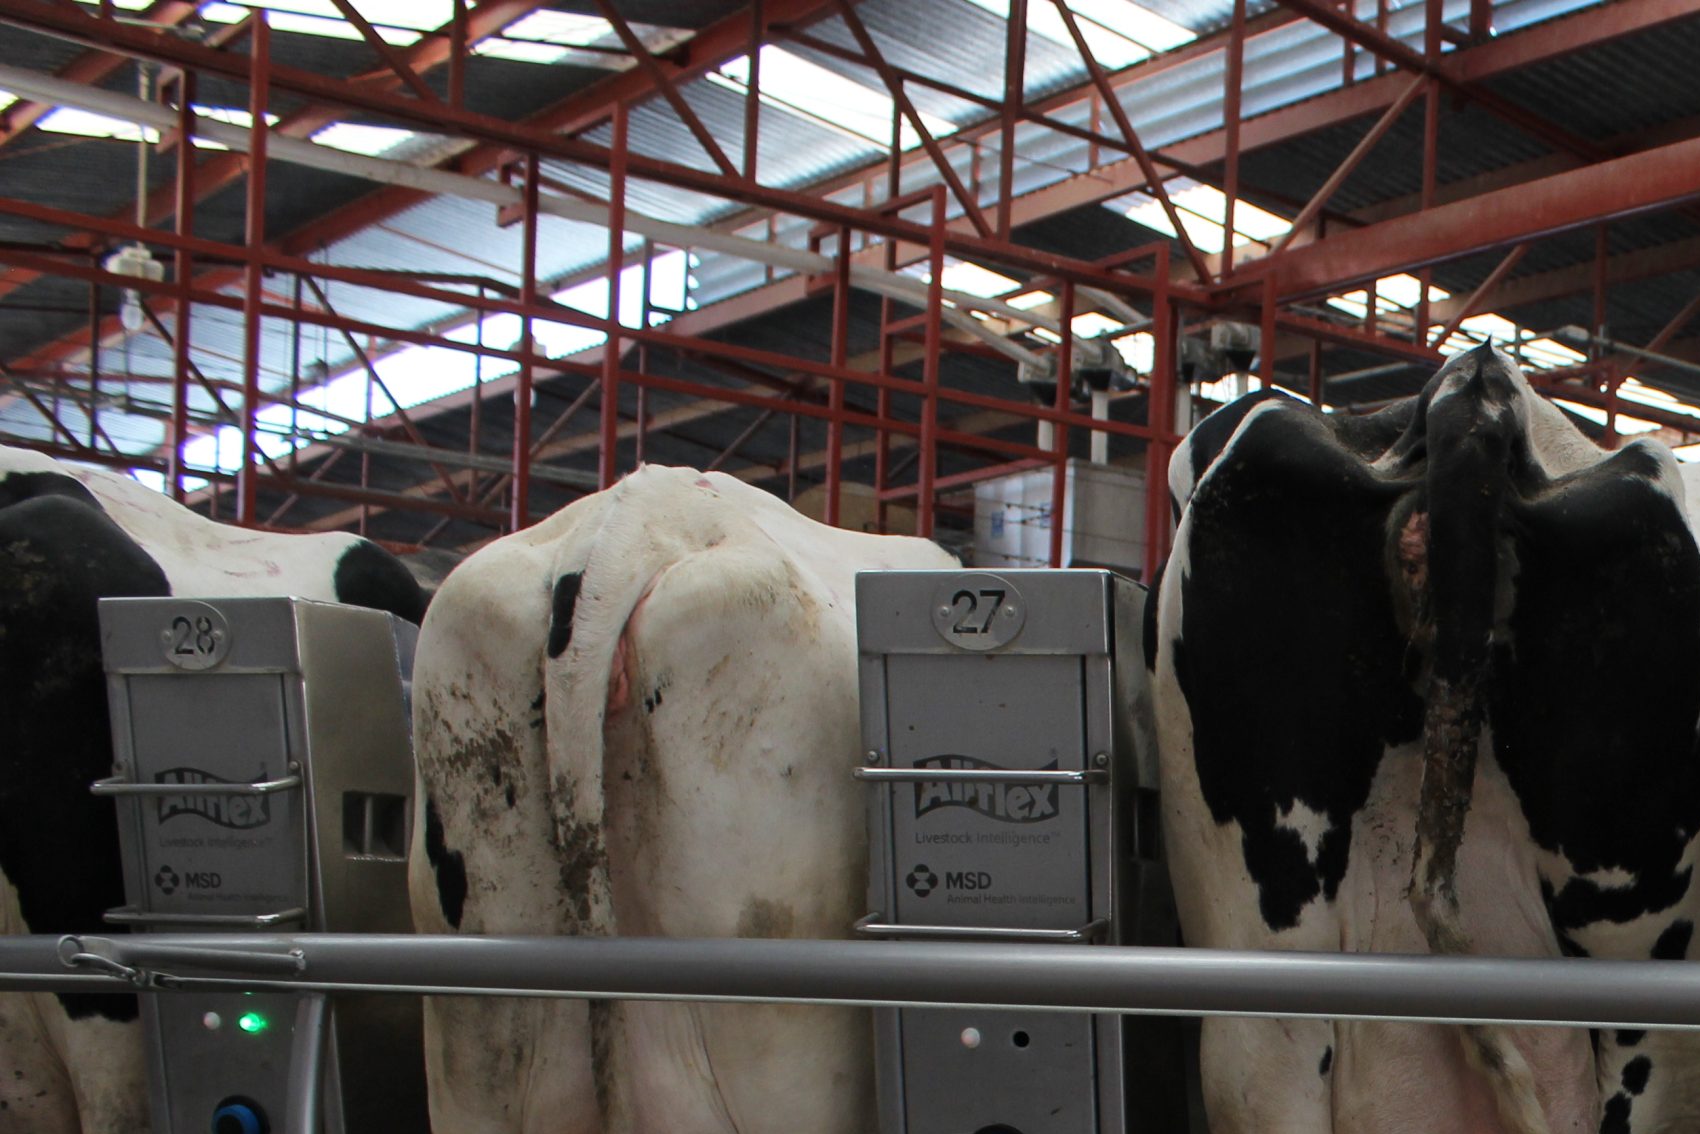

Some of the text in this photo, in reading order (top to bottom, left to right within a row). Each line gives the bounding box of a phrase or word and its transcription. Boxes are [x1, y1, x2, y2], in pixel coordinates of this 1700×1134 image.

[951, 590, 1006, 634] 27
[172, 616, 215, 655] 28
[915, 831, 973, 844] Livestock
[185, 872, 222, 889] MSD
[945, 871, 992, 890] MSD
[947, 894, 1077, 907] Animal Health Intelligence
